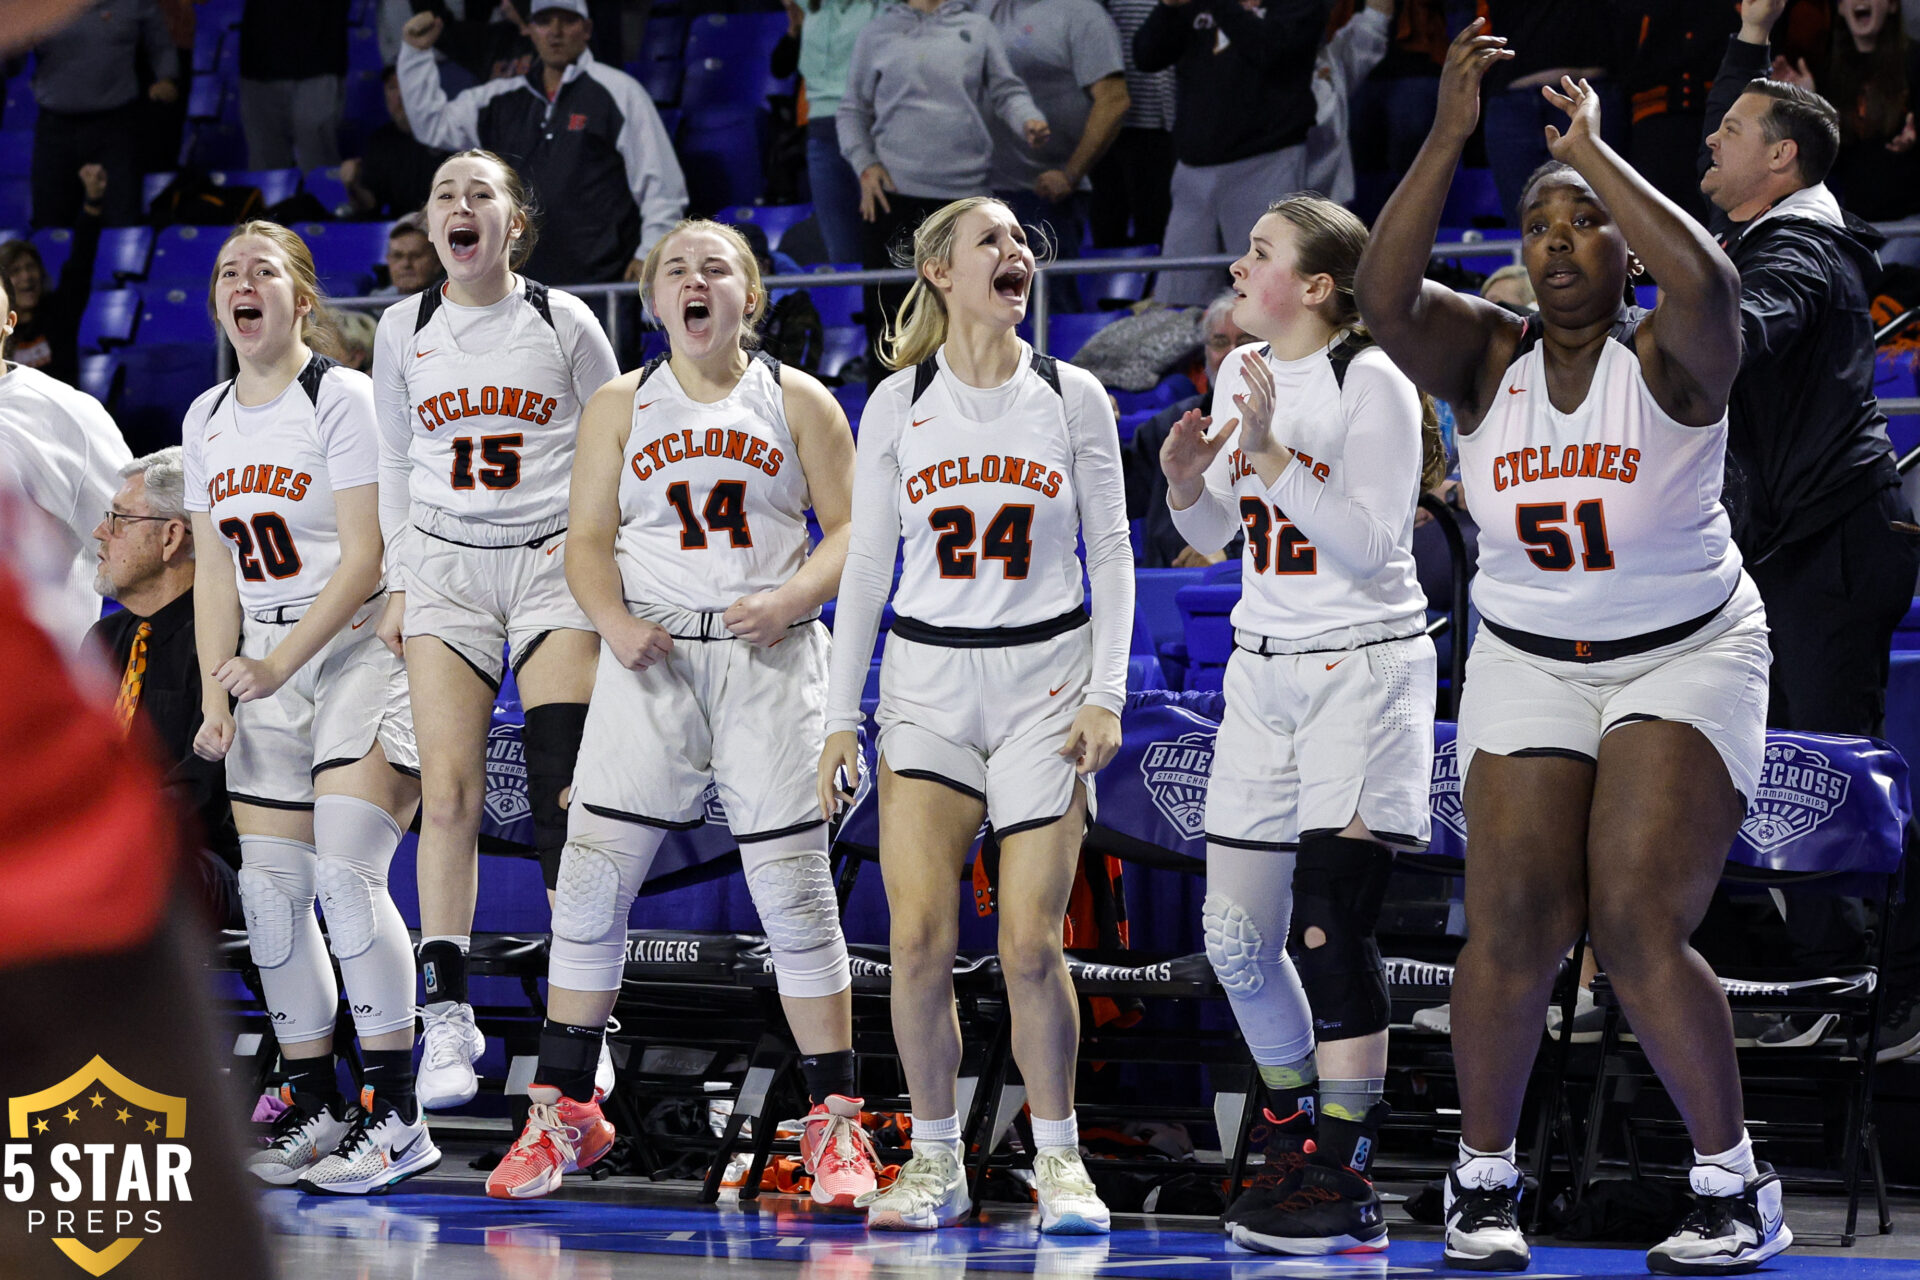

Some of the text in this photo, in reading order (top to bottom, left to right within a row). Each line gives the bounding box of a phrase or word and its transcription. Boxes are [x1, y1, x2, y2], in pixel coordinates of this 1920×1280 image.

[417, 385, 557, 432] CYCLONES
[450, 432, 523, 490] 15
[631, 428, 784, 481] CYCLONES
[1493, 443, 1641, 492] CYCLONES
[207, 464, 312, 508] YCLONES
[906, 455, 1063, 504] CYCLONES
[665, 479, 753, 550] 14
[1239, 496, 1317, 575] 32
[1515, 498, 1615, 571] 51
[219, 511, 303, 582] 20
[928, 503, 1035, 580] 24
[1156, 772, 1184, 782] STATE
[1756, 789, 1825, 809] HAMPIONSHIPS
[1759, 762, 1842, 799] ECROSS
[625, 940, 700, 962] RAIDERS
[1081, 962, 1171, 982] RAIDERS
